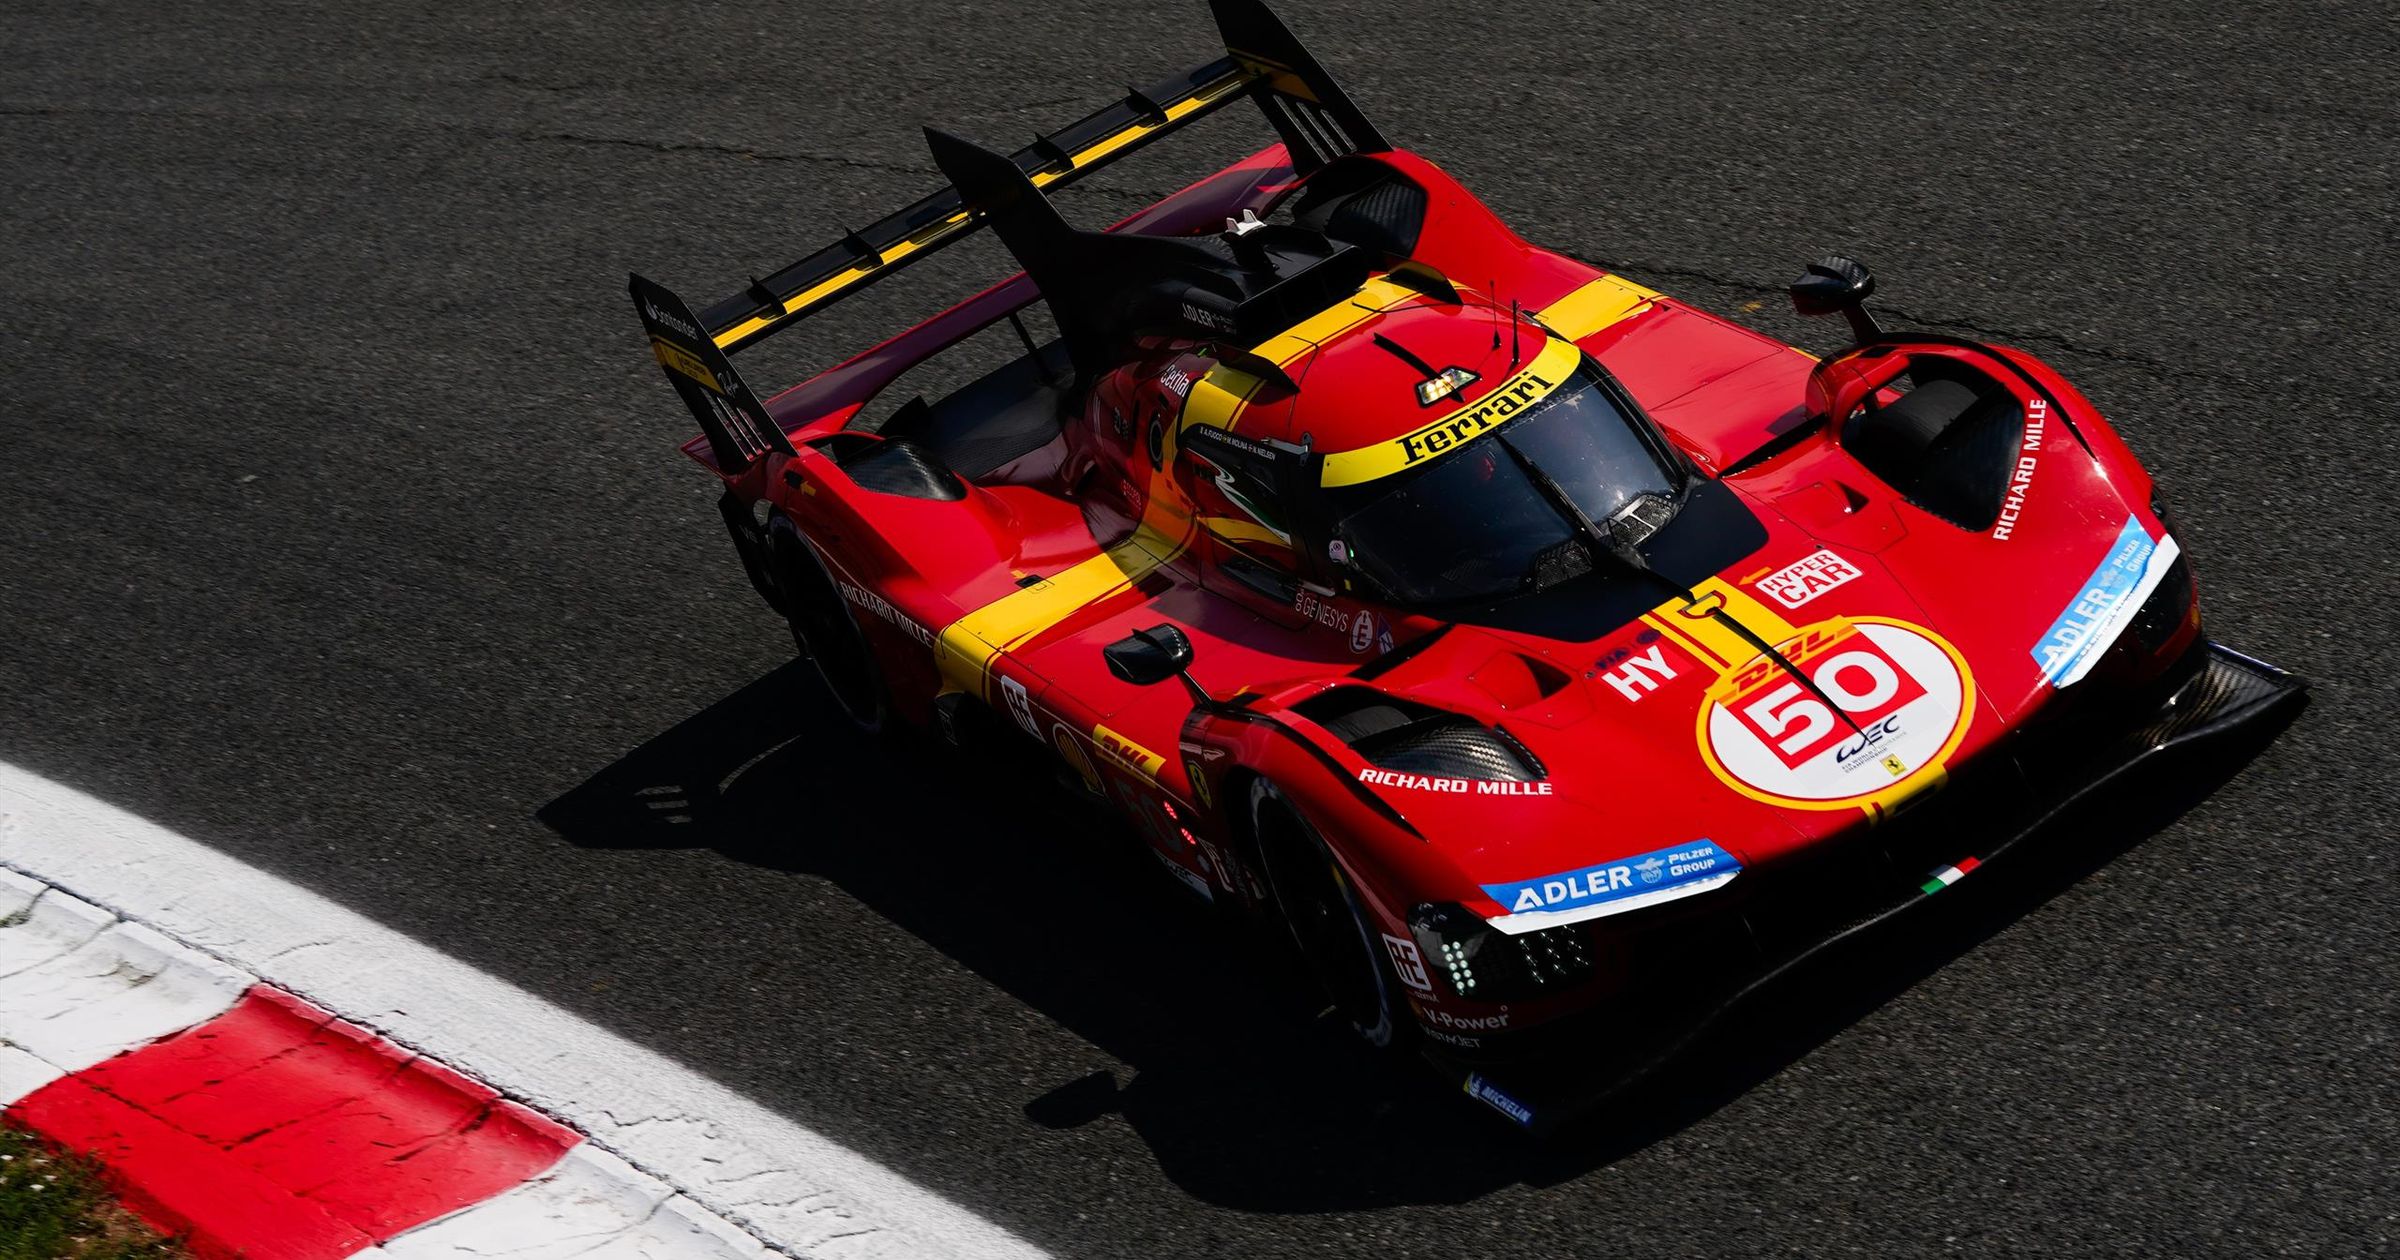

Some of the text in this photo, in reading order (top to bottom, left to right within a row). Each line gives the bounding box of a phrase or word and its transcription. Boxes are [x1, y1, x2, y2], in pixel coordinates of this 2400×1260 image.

[1396, 371, 1554, 465] Ferrari
[1993, 399, 2047, 541] RICHARD MILLE
[1763, 554, 1834, 592] HYPER
[1778, 563, 1854, 603] CAR
[840, 581, 933, 648] RICHARD MILLE
[1303, 597, 1349, 633] GENESYS
[2041, 588, 2117, 672] ADLER
[1601, 645, 1679, 703] HY
[1731, 630, 1836, 692] DHL
[1742, 651, 1900, 756] 50
[1836, 714, 1900, 763] WEC
[1359, 768, 1553, 796] RICHARD MILLE
[1668, 847, 1714, 864] PELZER
[1670, 858, 1715, 877] GROUP
[1513, 866, 1634, 912] ADLER
[1422, 1006, 1510, 1030] V-Power
[1481, 1086, 1532, 1123] MICHELIN
